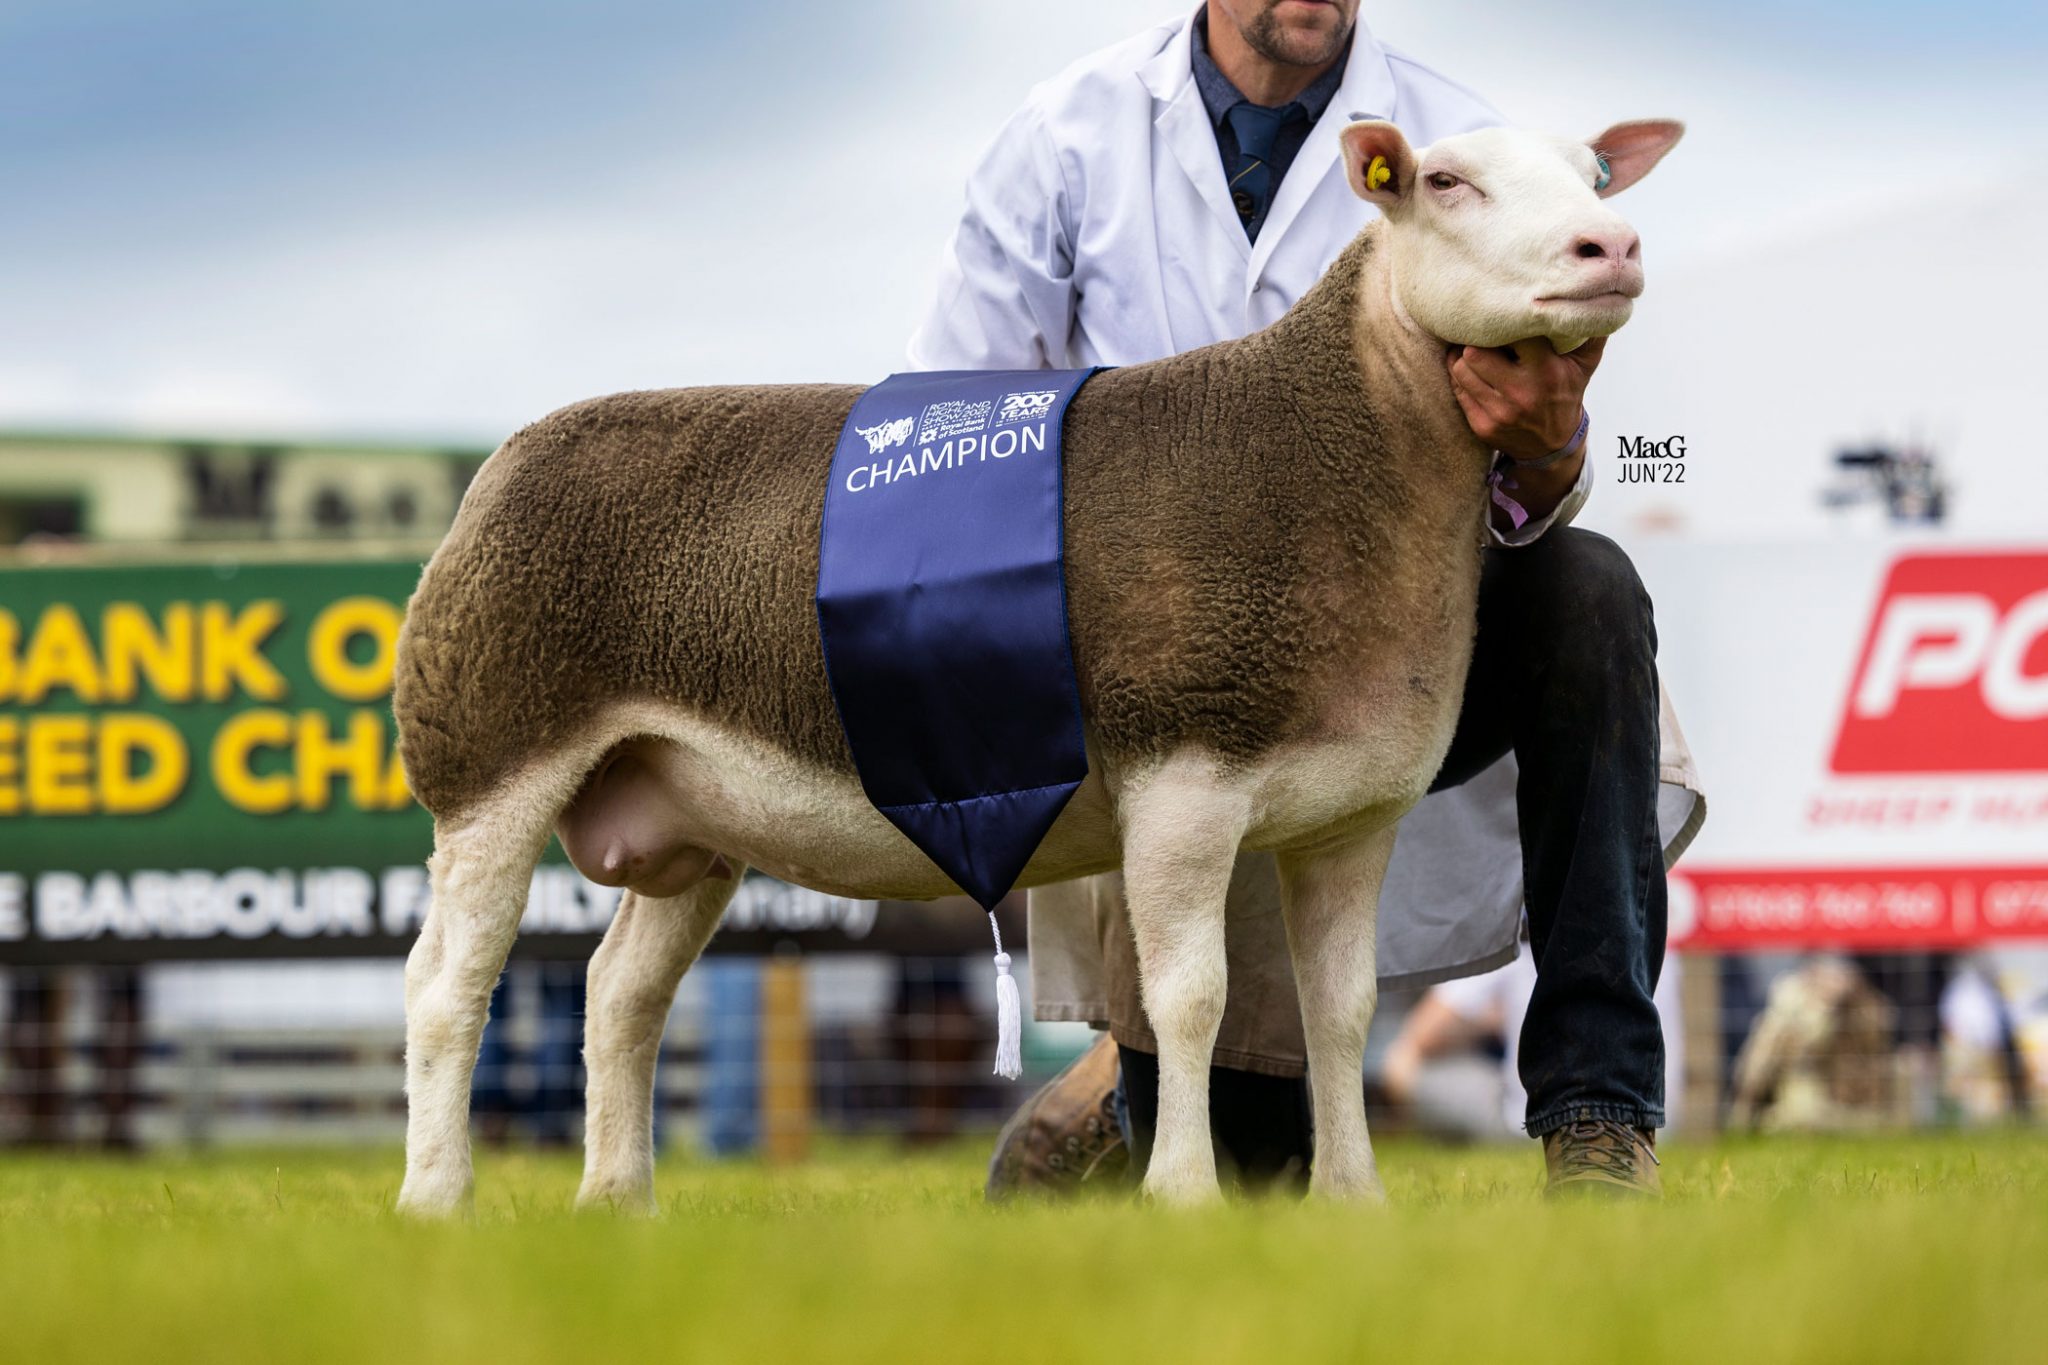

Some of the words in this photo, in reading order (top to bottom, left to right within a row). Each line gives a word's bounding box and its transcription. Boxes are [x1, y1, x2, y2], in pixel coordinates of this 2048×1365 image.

[926, 401, 991, 418] HIGHLAND
[929, 400, 965, 412] ROYAL
[1001, 393, 1056, 411] 200
[922, 411, 962, 426] SHOW
[962, 406, 992, 418] 2022
[1000, 405, 1050, 420] YEARS
[938, 430, 948, 440] of
[947, 423, 985, 437] Scotland
[940, 421, 963, 432] Royal
[964, 417, 985, 427] Bank
[845, 423, 1046, 492] CHAMPION
[36, 866, 375, 939] BARBOUR
